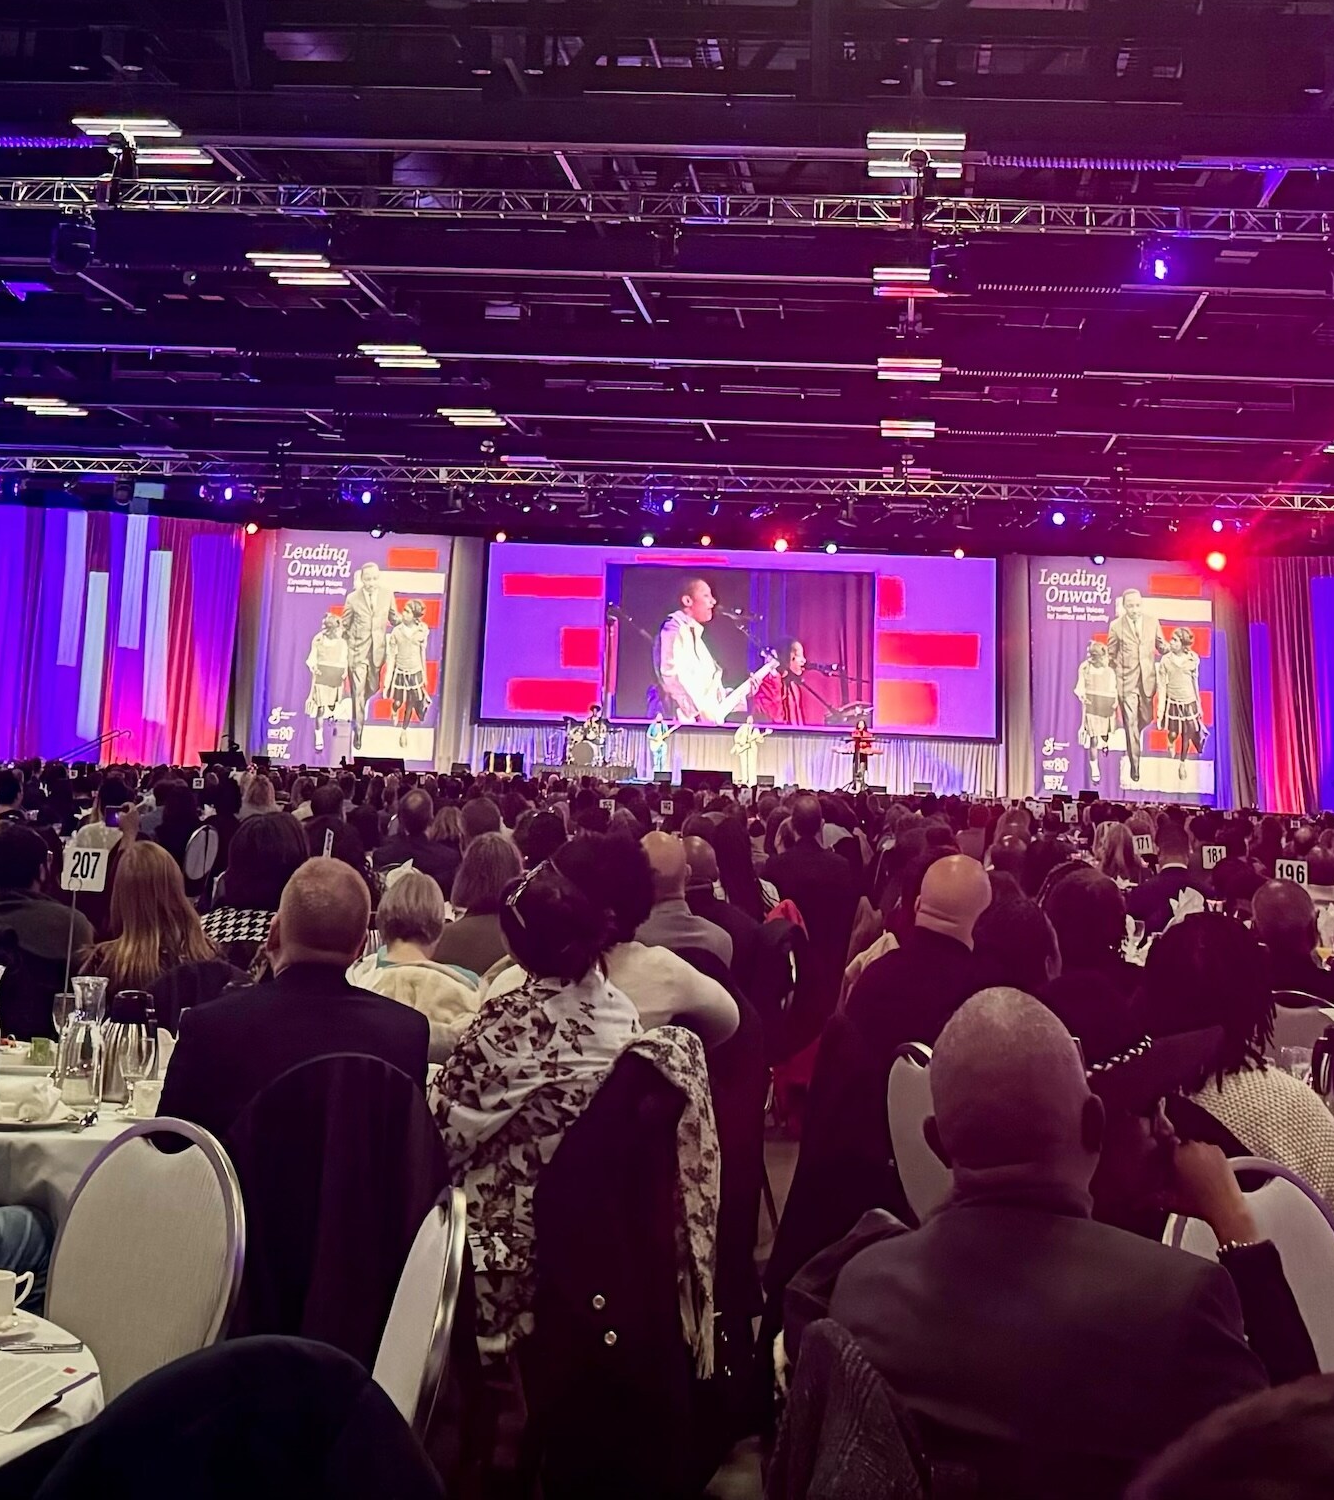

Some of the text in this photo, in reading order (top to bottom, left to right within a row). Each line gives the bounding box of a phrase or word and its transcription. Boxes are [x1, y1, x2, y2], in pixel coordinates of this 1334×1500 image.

[282, 543, 349, 564] Leading
[287, 560, 352, 578] Onward
[1038, 568, 1107, 591] Leading
[1045, 586, 1112, 605] Onward
[1136, 836, 1150, 850] 171
[1207, 847, 1222, 863] 181
[70, 851, 101, 880] 207
[1278, 863, 1305, 884] 196
